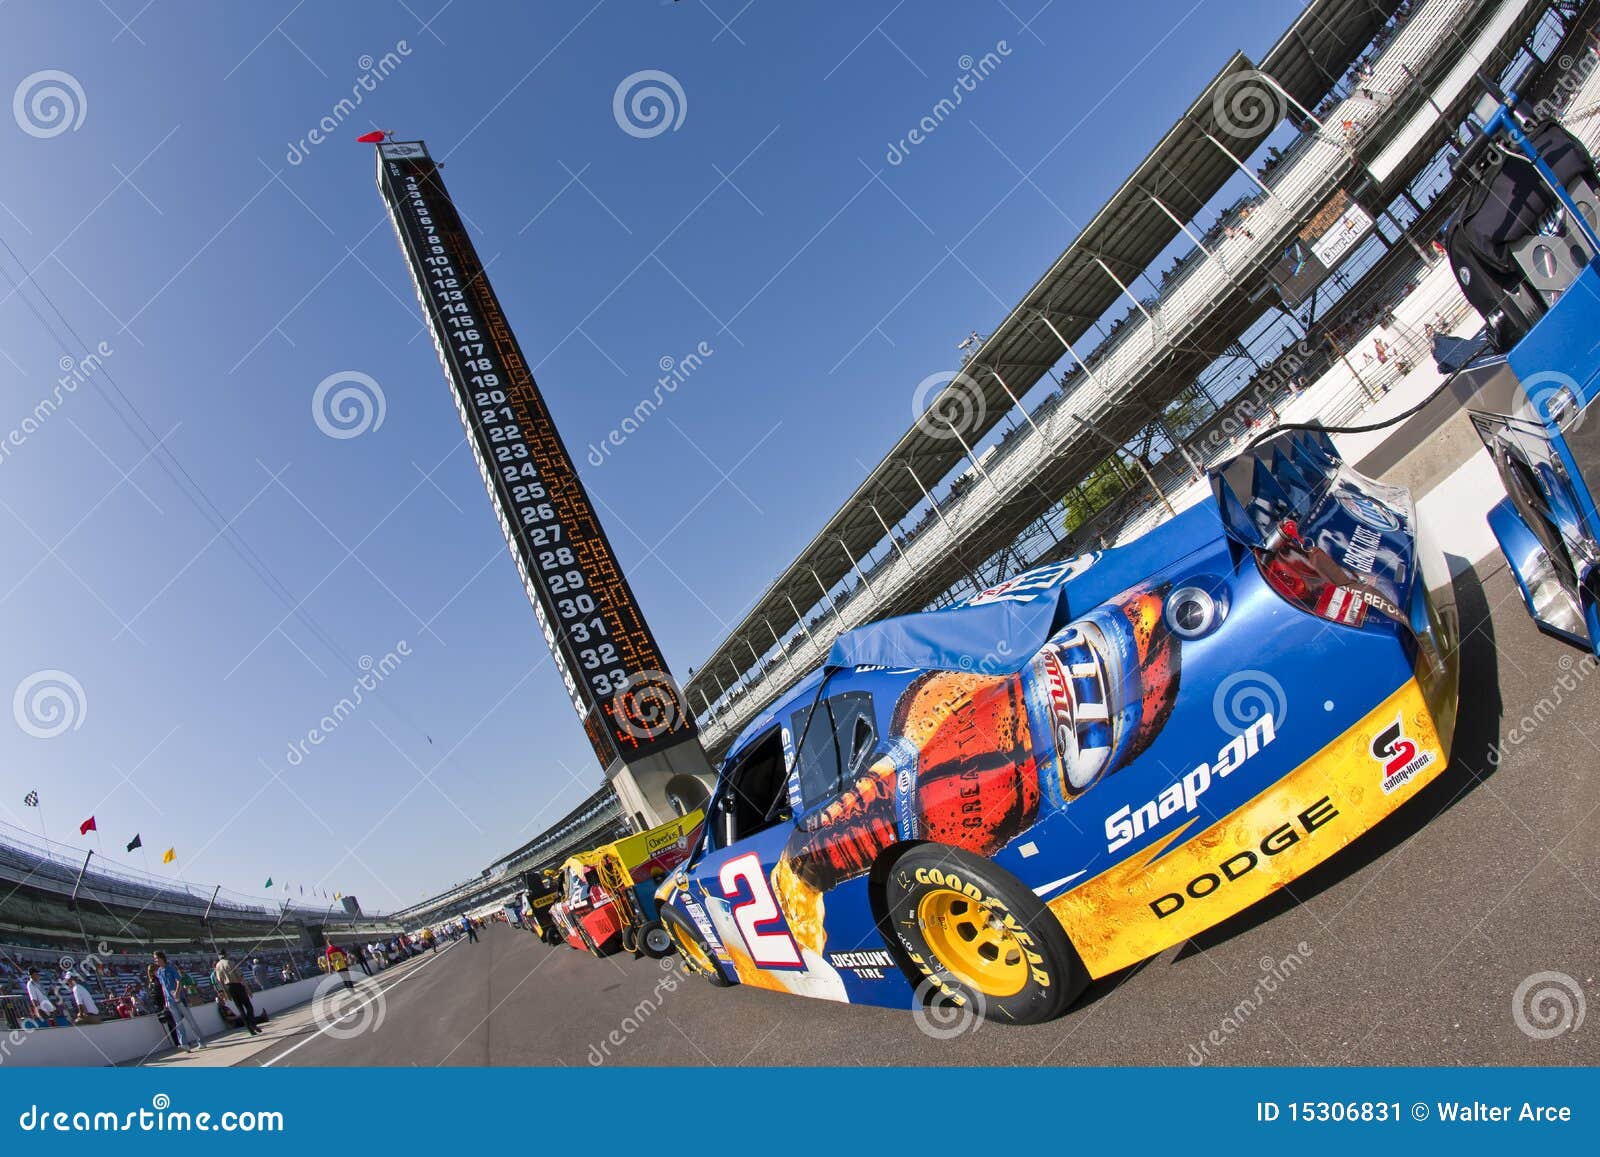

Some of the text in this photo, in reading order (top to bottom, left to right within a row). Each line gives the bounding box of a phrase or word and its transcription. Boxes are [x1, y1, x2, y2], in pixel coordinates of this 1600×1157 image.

[424, 226, 434, 234] 7
[428, 236, 440, 244] 8
[432, 246, 444, 254] 9
[425, 257, 448, 265] 10
[431, 267, 454, 276] 11
[434, 278, 459, 288] 12
[438, 291, 463, 301] 13
[442, 303, 468, 313] 14
[448, 316, 474, 327] 15
[453, 330, 480, 341] 16
[459, 344, 483, 356] 17
[465, 358, 493, 371] 18
[471, 375, 499, 387] 19
[475, 389, 506, 406] 20
[482, 407, 515, 423] 21
[489, 424, 521, 442] 22
[496, 439, 528, 461] 23
[502, 462, 537, 482] 24
[512, 483, 545, 502] 25
[521, 503, 554, 524] 26
[530, 525, 561, 546] 27
[539, 547, 574, 570] 28
[549, 570, 584, 594] 29
[558, 594, 594, 618] 30
[571, 617, 607, 642] 31
[581, 643, 619, 669] 32
[592, 668, 629, 695] 33
[1104, 712, 1277, 854] Snap-on
[1148, 795, 1341, 920] DODGE
[719, 851, 808, 972] 2
[831, 949, 895, 968] DISCOUNT
[853, 967, 885, 980] TIRE
